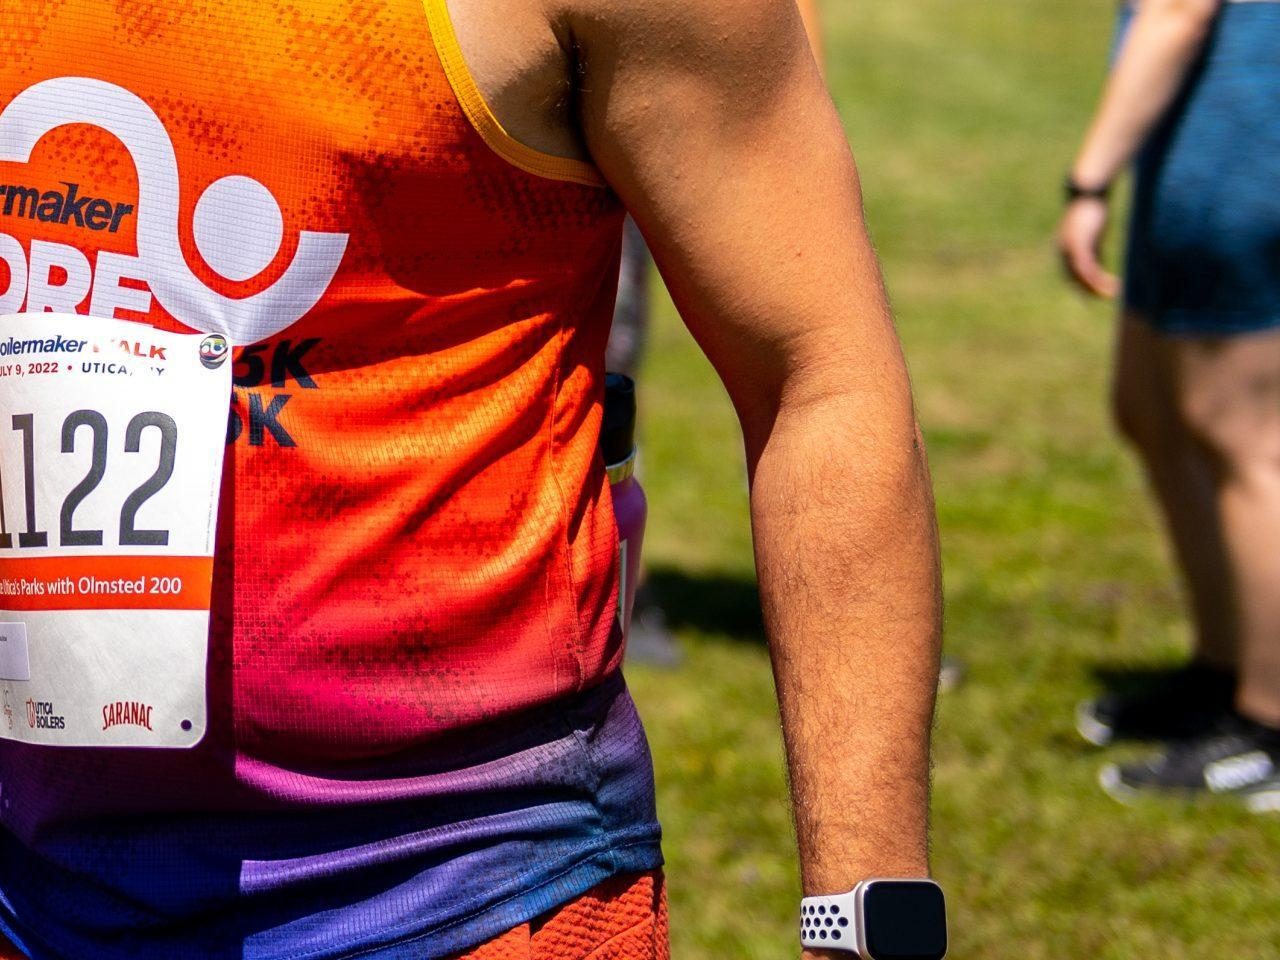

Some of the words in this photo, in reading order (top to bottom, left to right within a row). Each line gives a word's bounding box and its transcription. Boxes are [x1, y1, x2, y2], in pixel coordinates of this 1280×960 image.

[92, 338, 167, 360] ALK
[15, 364, 25, 377] 9,
[28, 362, 59, 375] 2022
[21, 578, 45, 595] Parks
[47, 577, 74, 595] with
[78, 576, 145, 595] Olmsted
[150, 577, 182, 594] 200
[35, 702, 53, 715] UTICA
[102, 701, 153, 731] SARANAC
[37, 716, 65, 729] BOILERS
